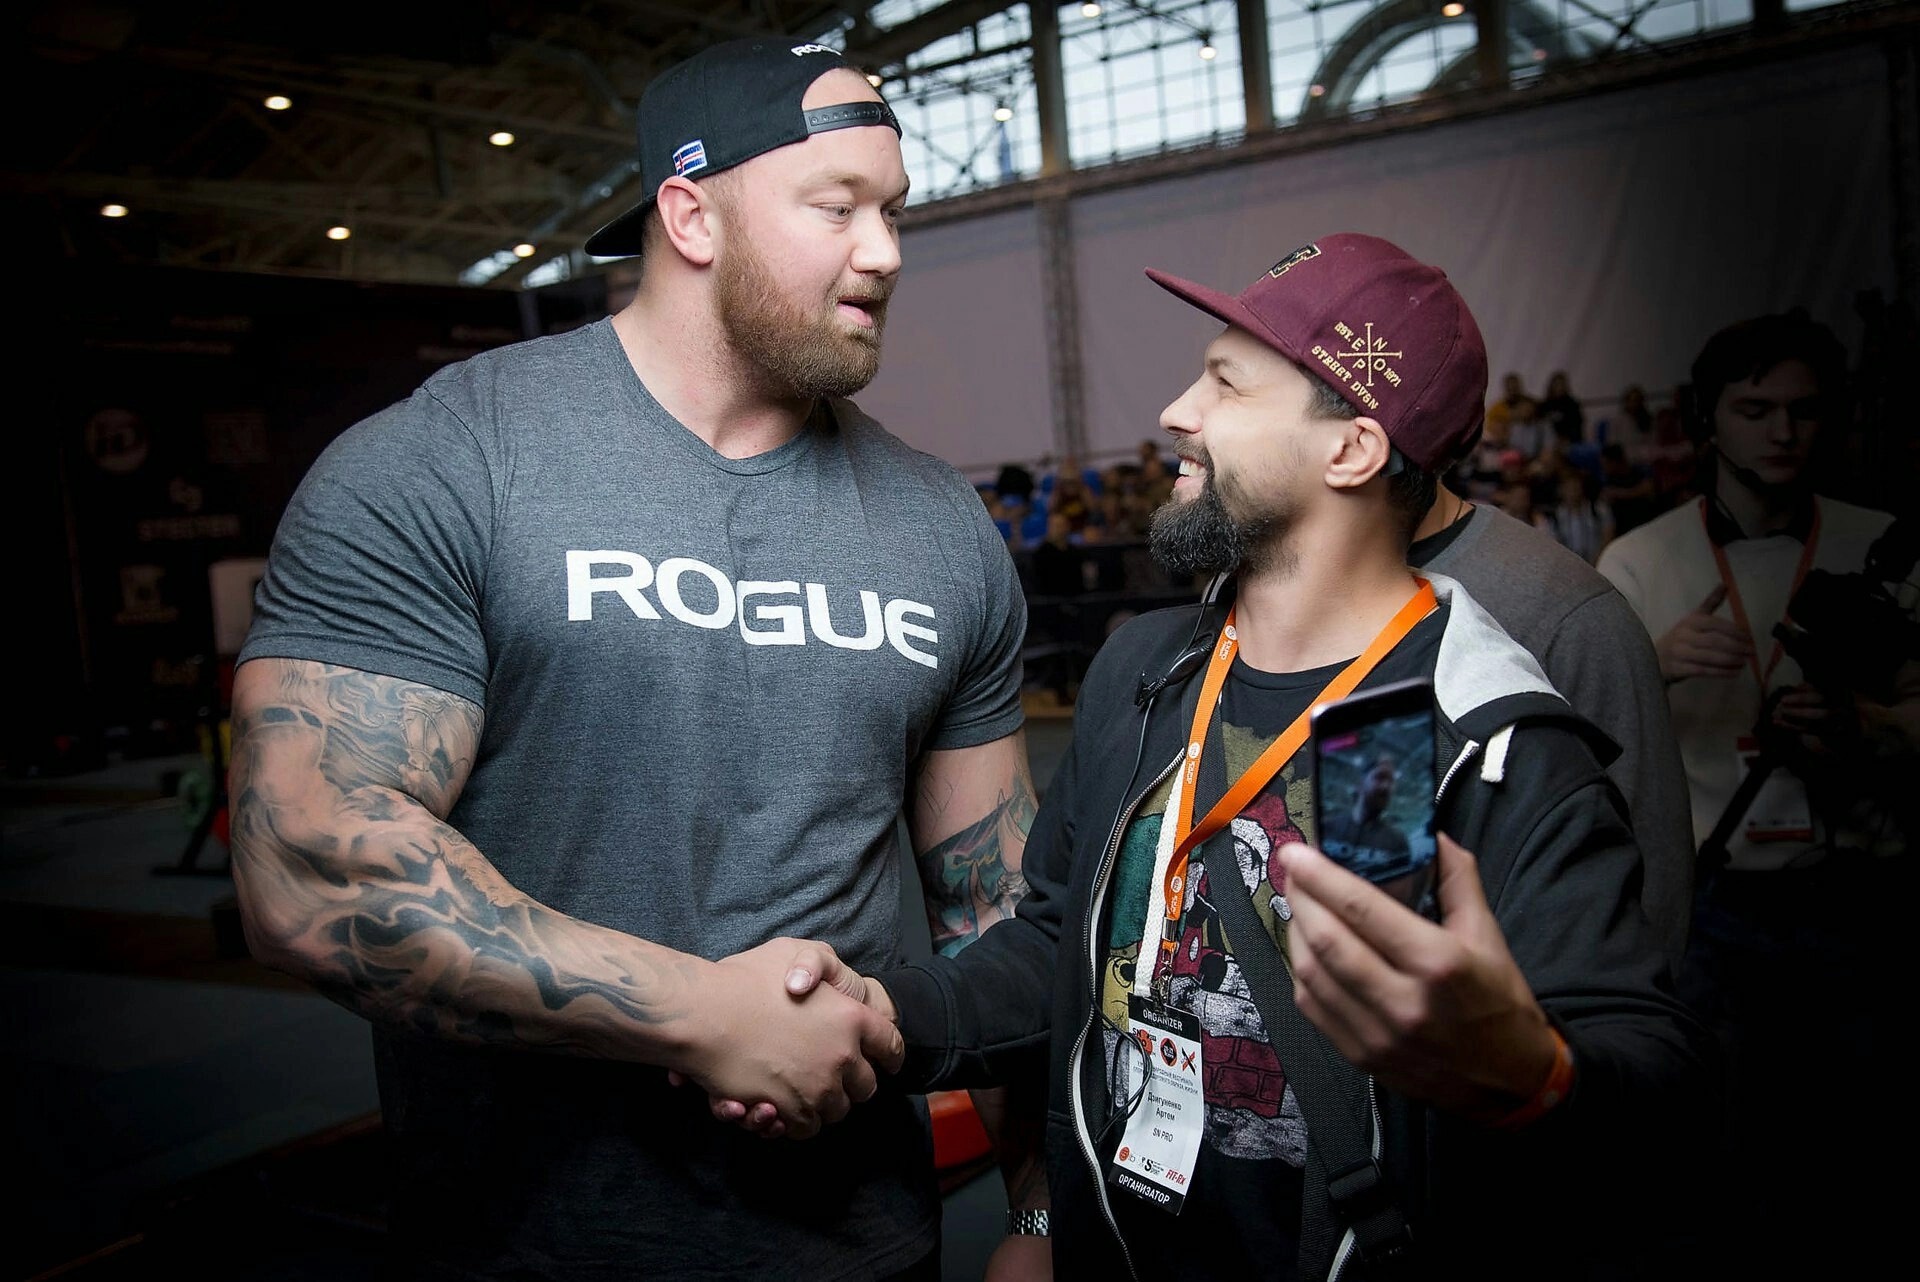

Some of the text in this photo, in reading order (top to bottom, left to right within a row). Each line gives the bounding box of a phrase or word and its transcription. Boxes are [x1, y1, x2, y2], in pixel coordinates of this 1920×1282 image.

[1311, 345, 1379, 410] STREET DVSN
[565, 549, 939, 669] ROGUE
[1142, 1008, 1183, 1031] ORGANIZER
[1155, 1107, 1175, 1121] Артем
[1152, 1127, 1174, 1143] SN PRO
[1118, 1173, 1170, 1204] ОРГАНИЗАТОР
